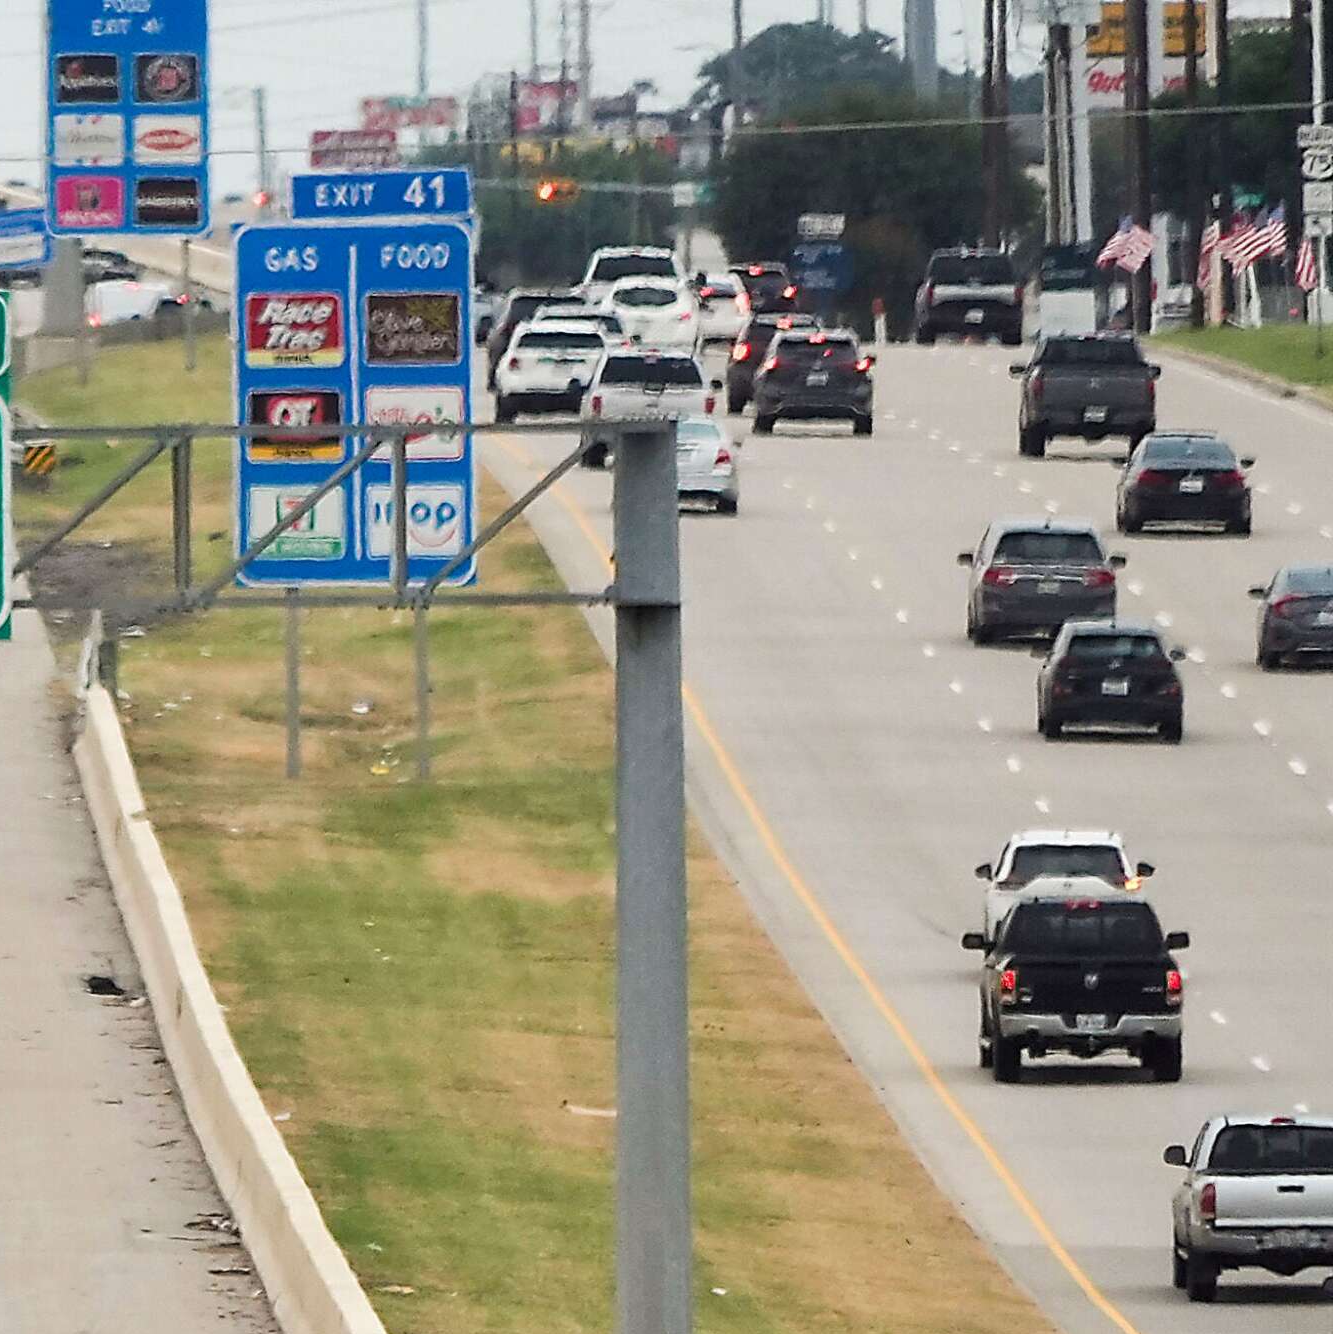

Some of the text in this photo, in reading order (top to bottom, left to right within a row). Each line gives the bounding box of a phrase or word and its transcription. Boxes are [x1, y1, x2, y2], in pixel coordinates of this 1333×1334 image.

[314, 175, 446, 208] EXIT 41
[265, 245, 319, 272] GAS
[380, 243, 451, 268] FOOD
[257, 300, 334, 325] Race
